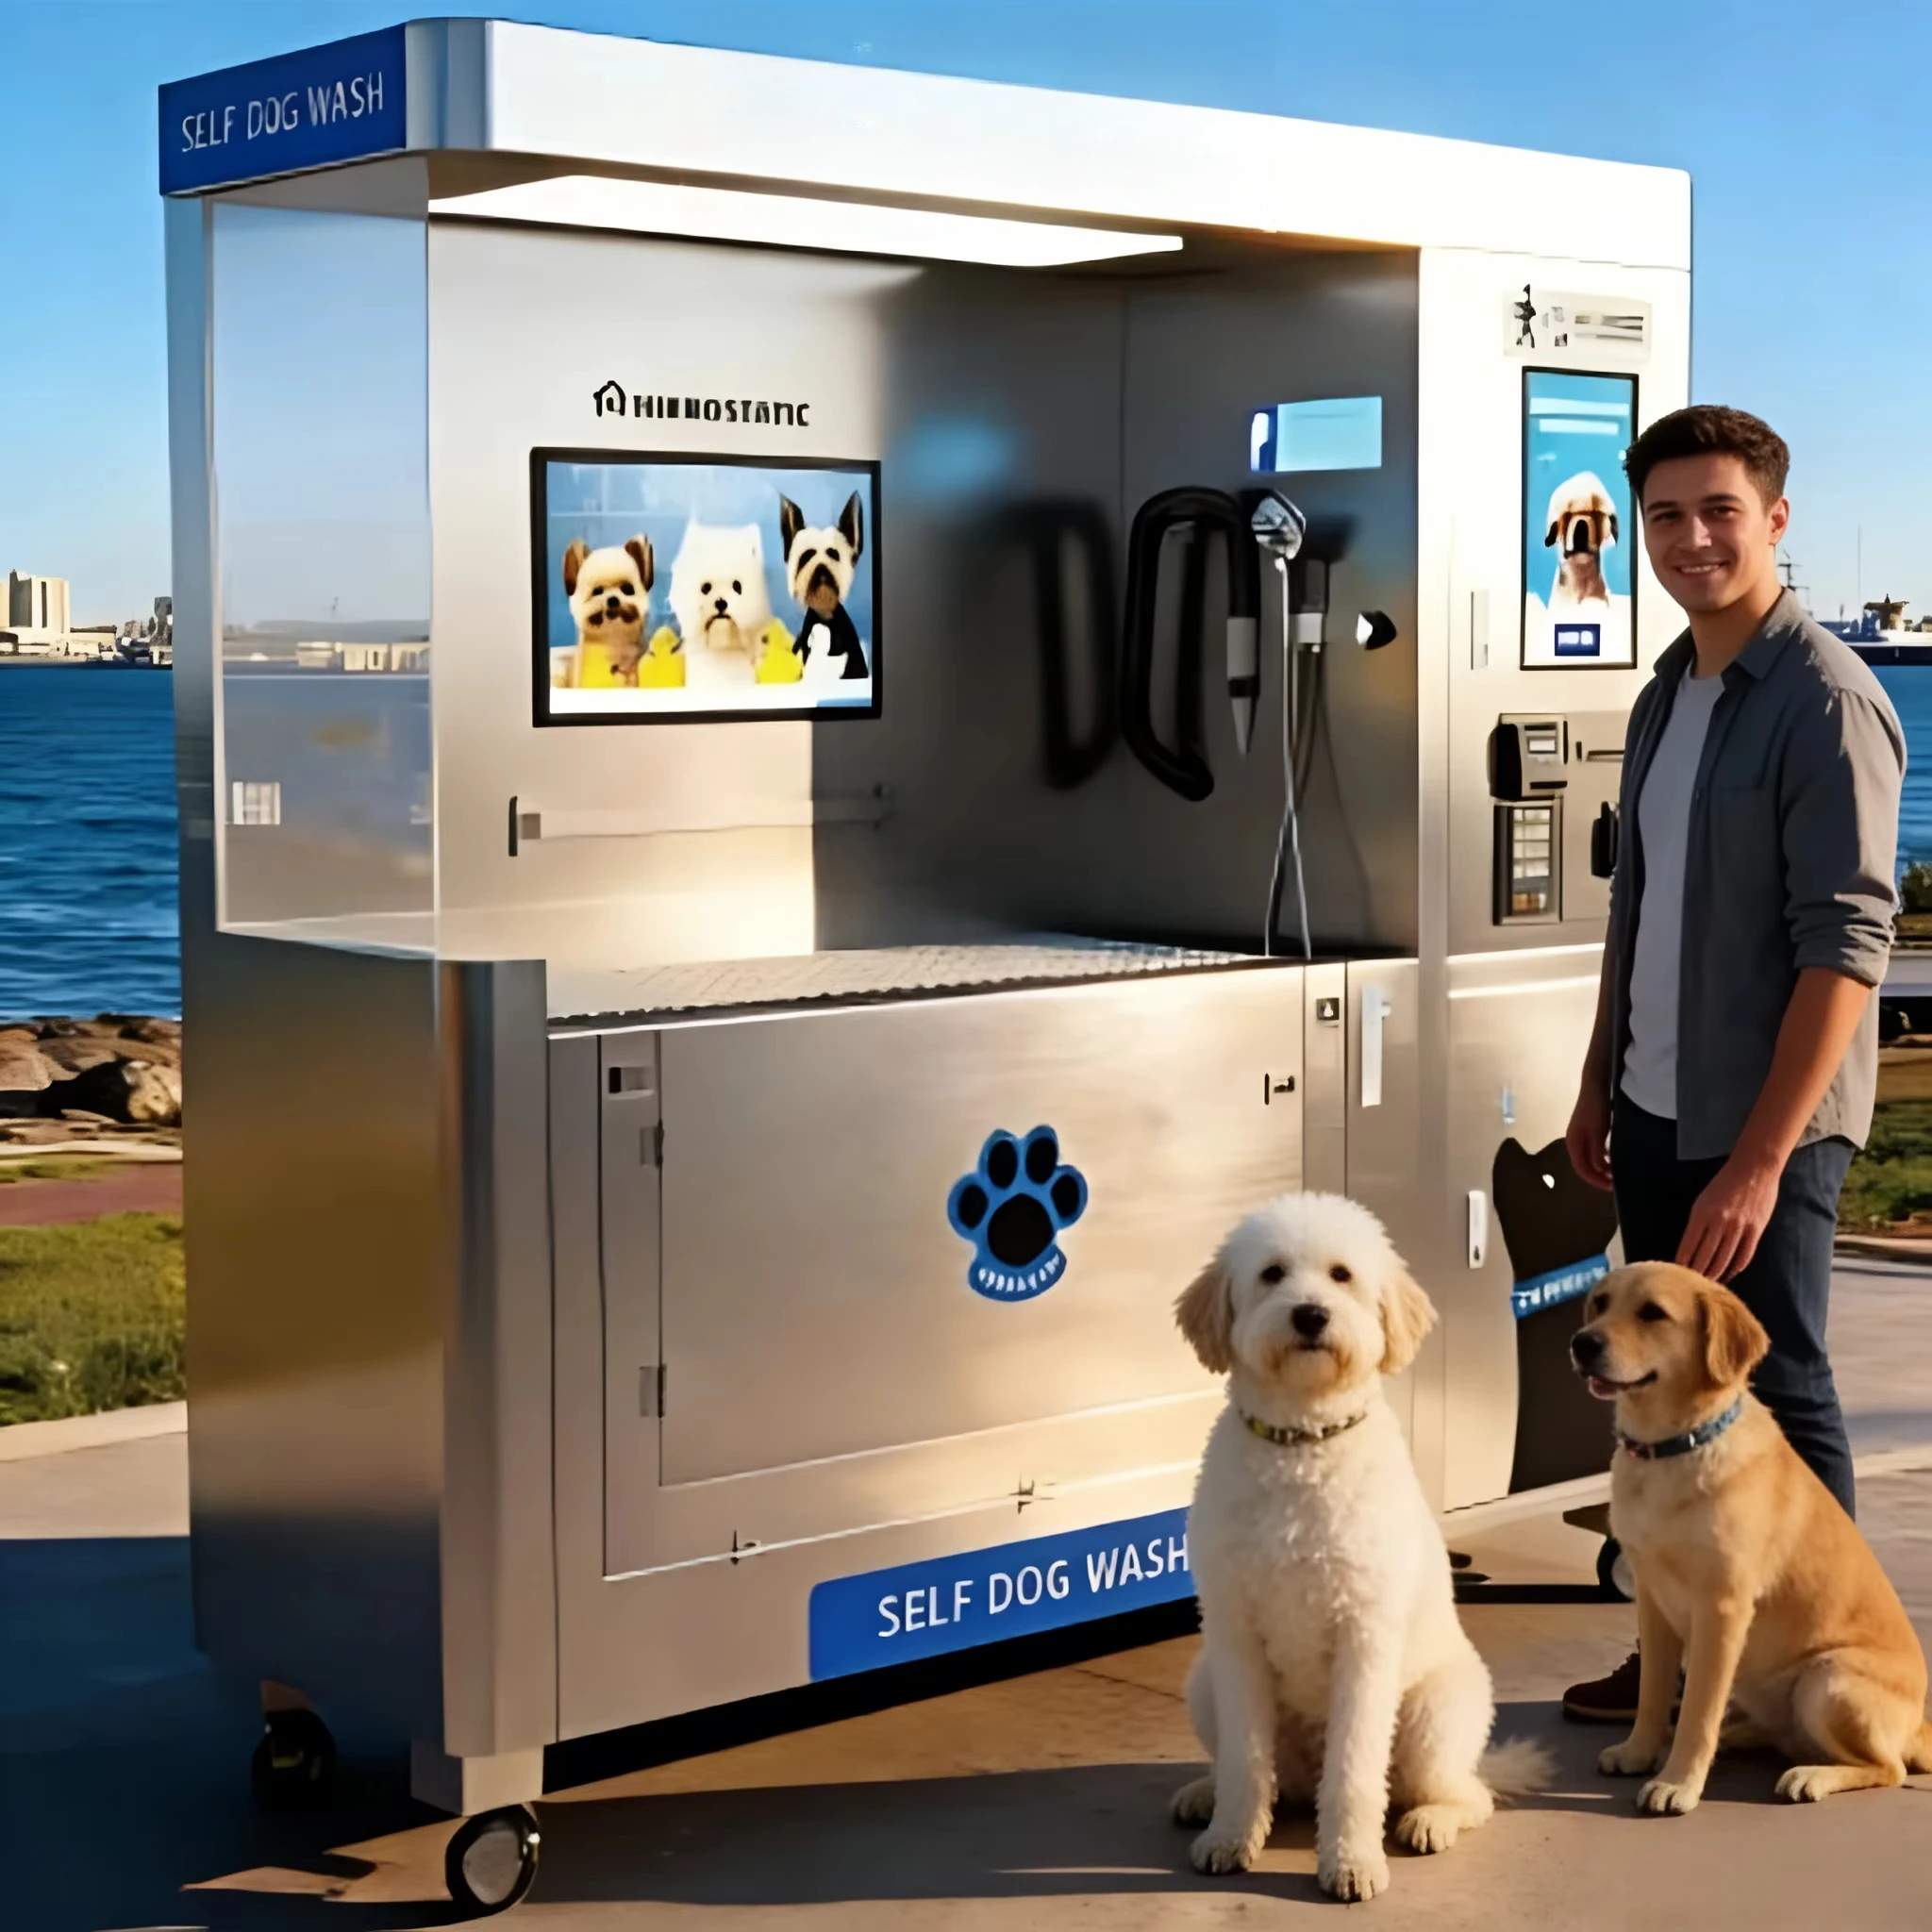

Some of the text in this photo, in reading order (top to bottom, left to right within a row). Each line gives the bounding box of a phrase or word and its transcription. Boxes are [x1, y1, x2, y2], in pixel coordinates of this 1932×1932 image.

[181, 71, 383, 153] SELF DOG WASH
[877, 1534, 1190, 1638] SELF DOG WASH
